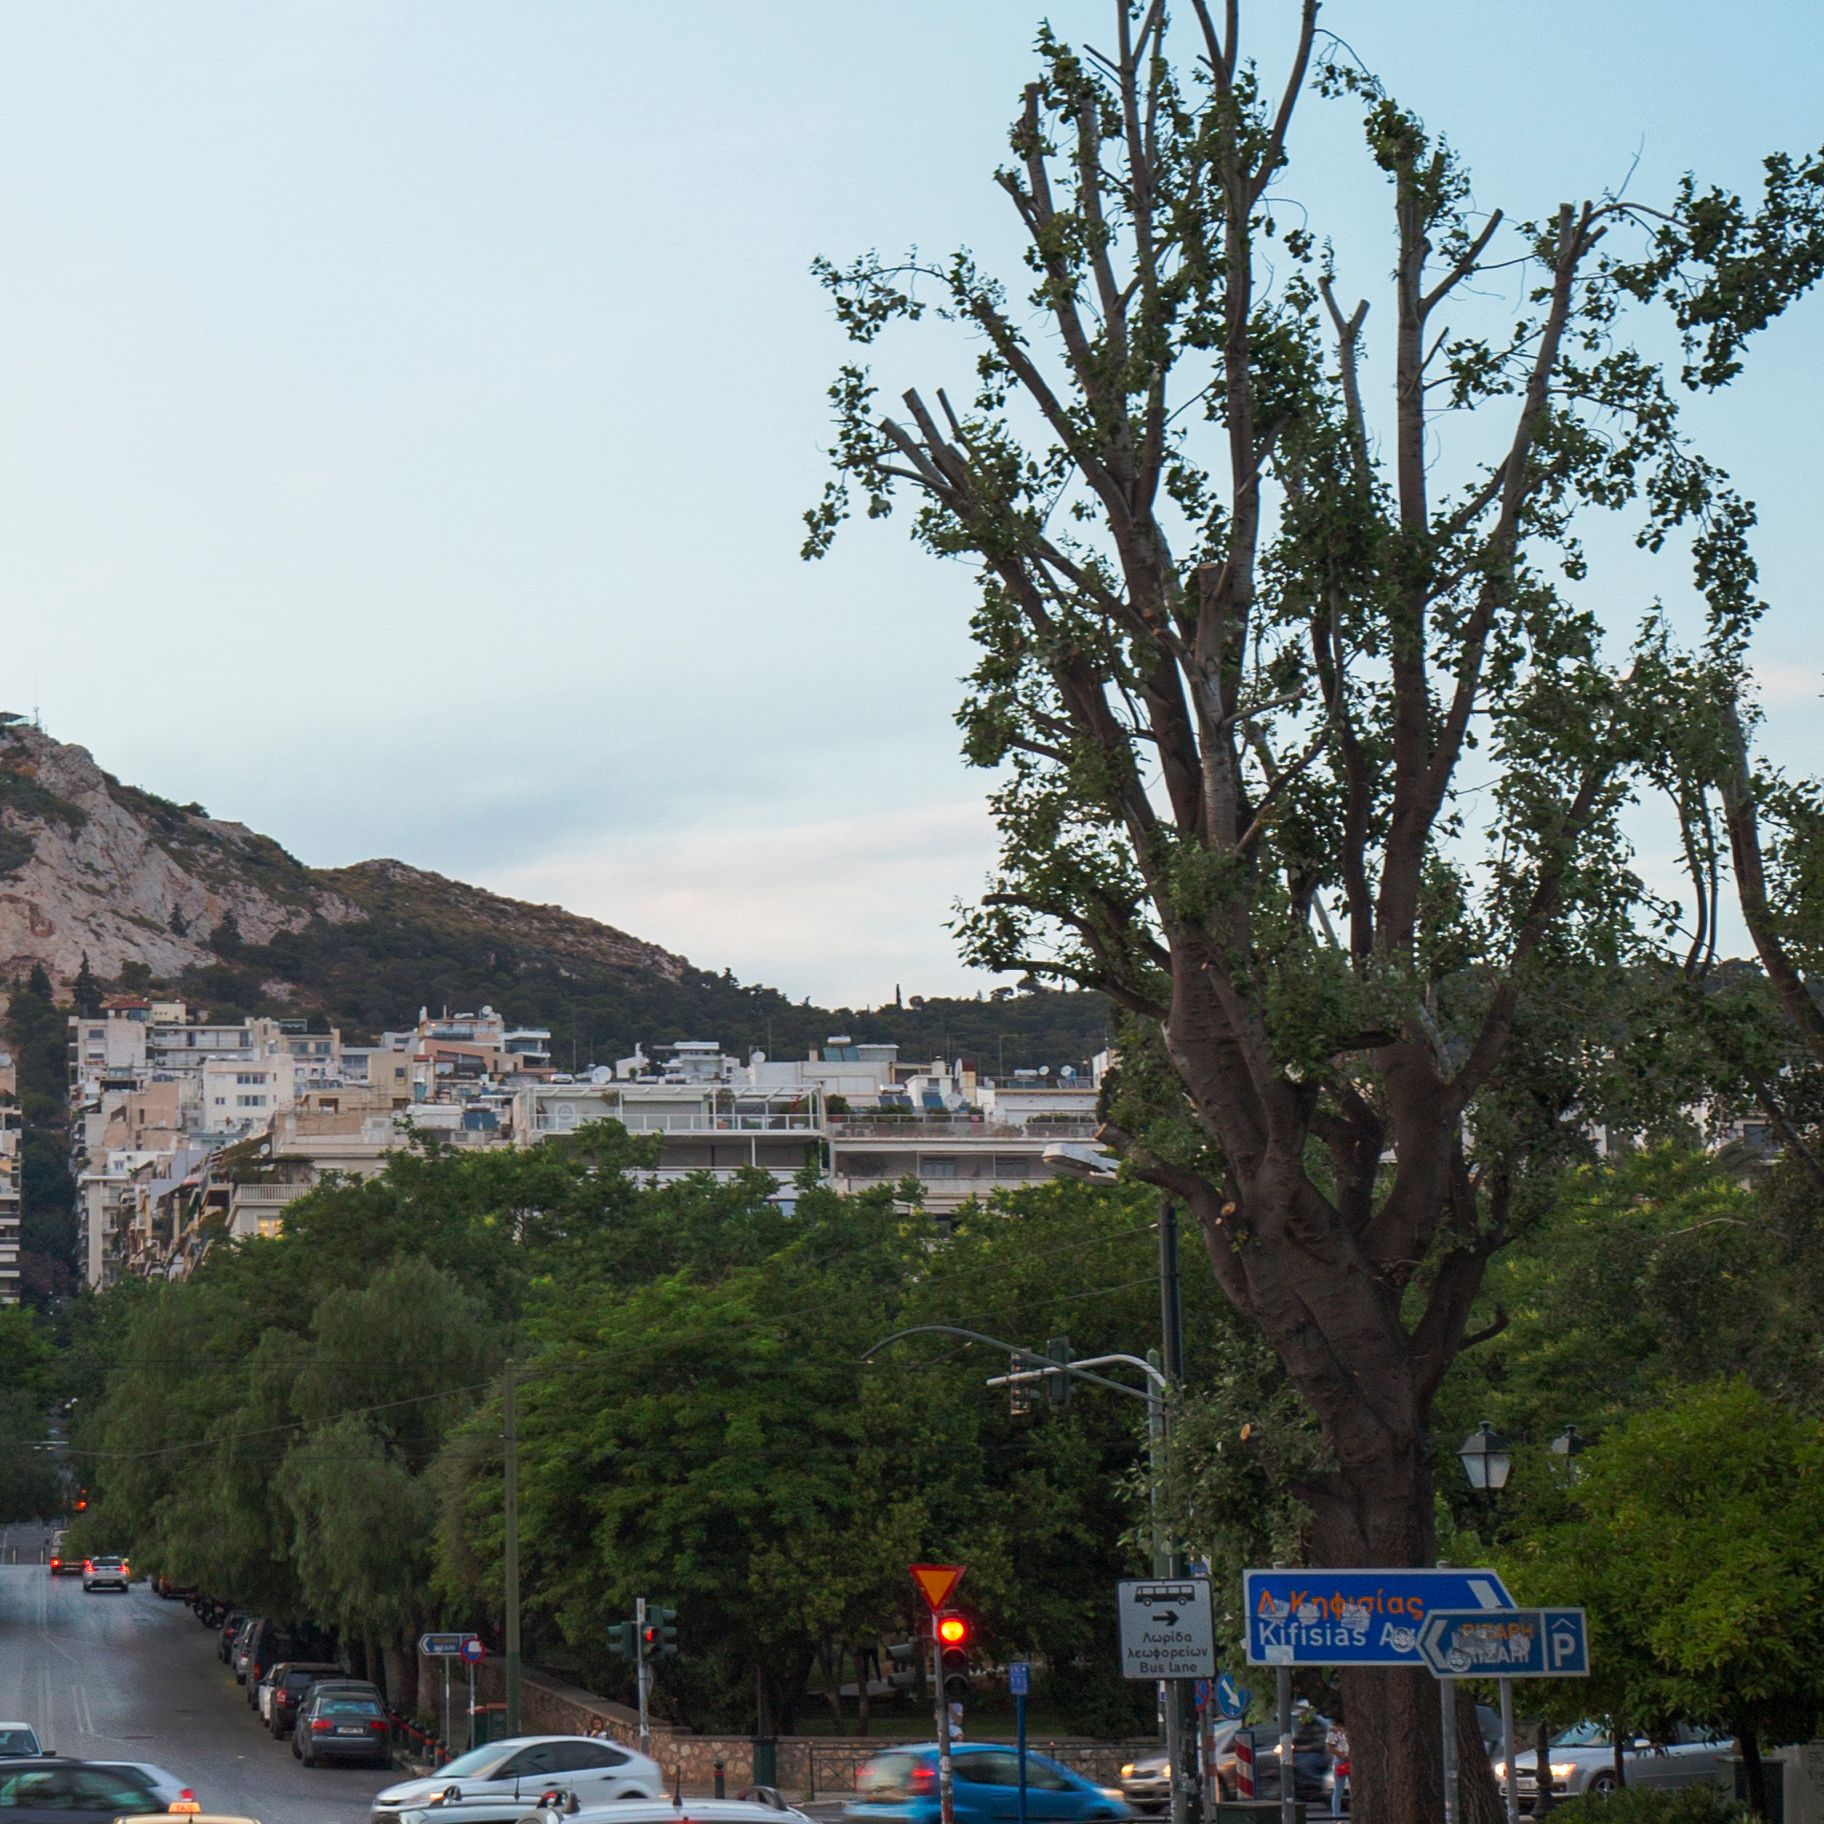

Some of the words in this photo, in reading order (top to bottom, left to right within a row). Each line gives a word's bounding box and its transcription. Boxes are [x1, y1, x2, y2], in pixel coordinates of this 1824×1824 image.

[1142, 1631, 1193, 1645] Λωρίδα
[1258, 1621, 1367, 1647] Kifisias
[1127, 1646, 1208, 1662] λεωφορείων
[1552, 1632, 1576, 1667] P
[1139, 1662, 1165, 1673] Bus
[1169, 1661, 1198, 1673] lane
